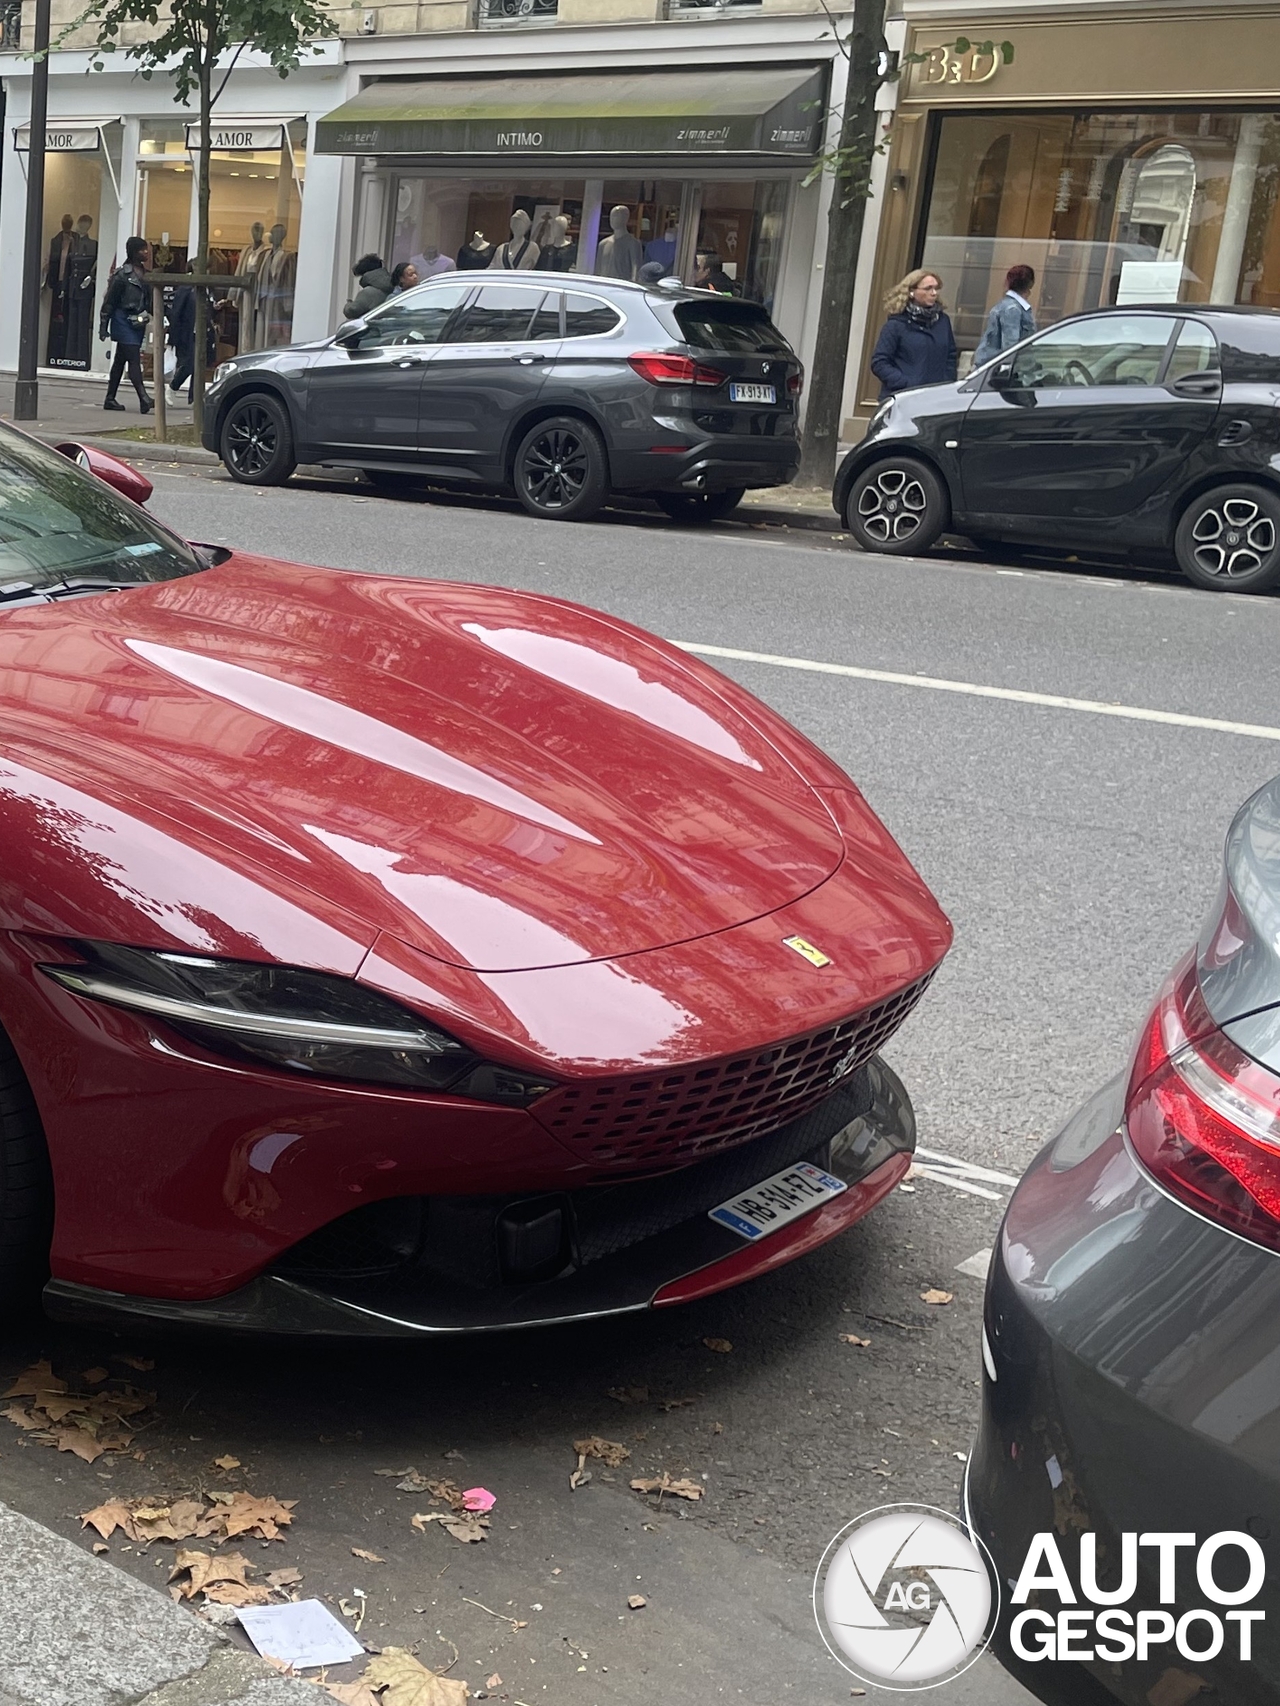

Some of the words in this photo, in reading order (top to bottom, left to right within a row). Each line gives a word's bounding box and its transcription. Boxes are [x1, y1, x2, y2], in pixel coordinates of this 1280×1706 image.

[47, 134, 73, 147] MOR
[215, 132, 253, 146] AMOR
[497, 132, 543, 146] INTIMO
